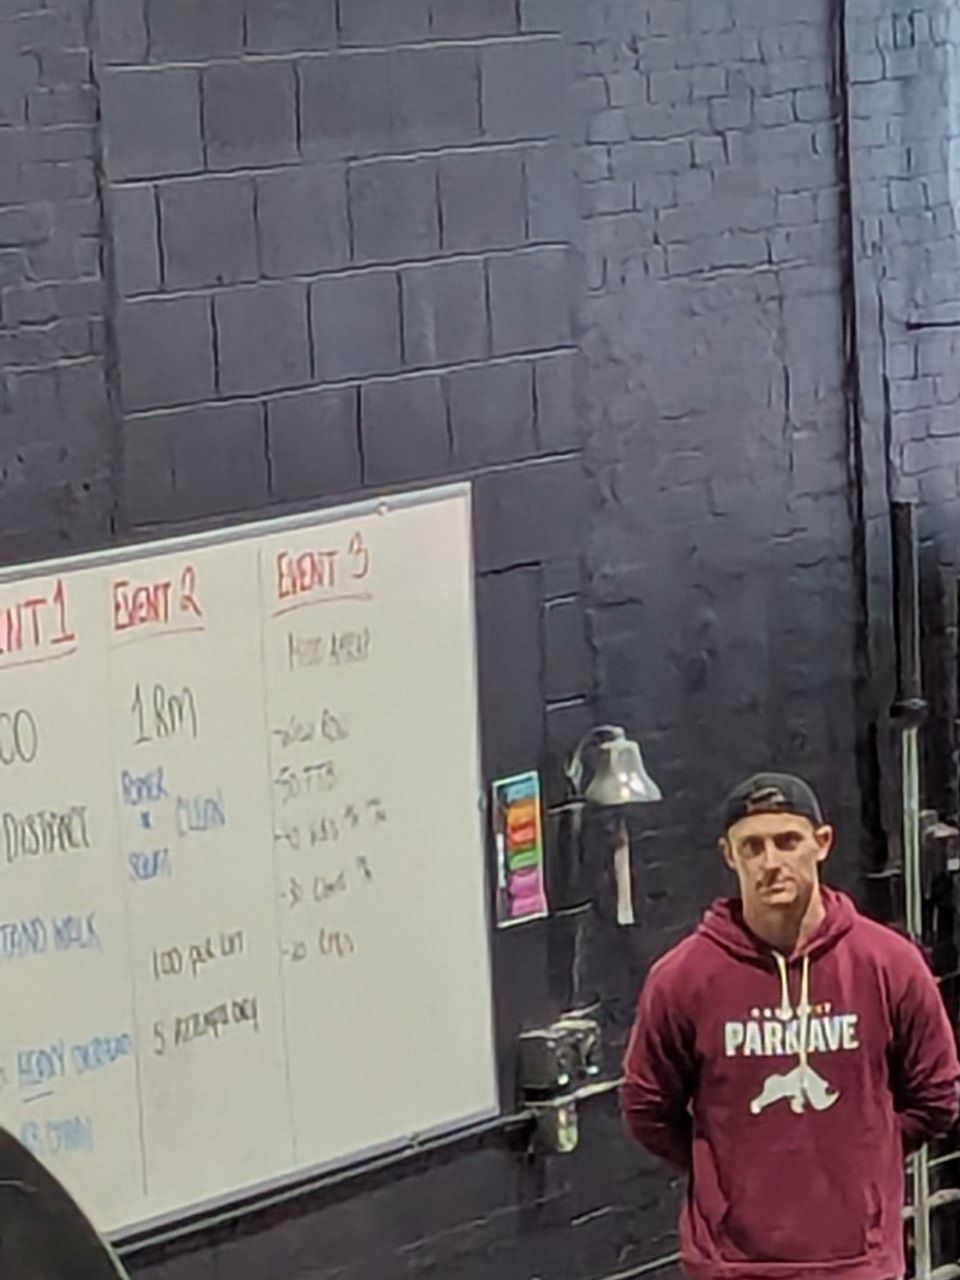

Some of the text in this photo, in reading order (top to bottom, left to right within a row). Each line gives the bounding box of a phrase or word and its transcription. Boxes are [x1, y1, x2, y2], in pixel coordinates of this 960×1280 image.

[114, 566, 202, 630] EVENT 2
[807, 1013, 860, 1053] AVE
